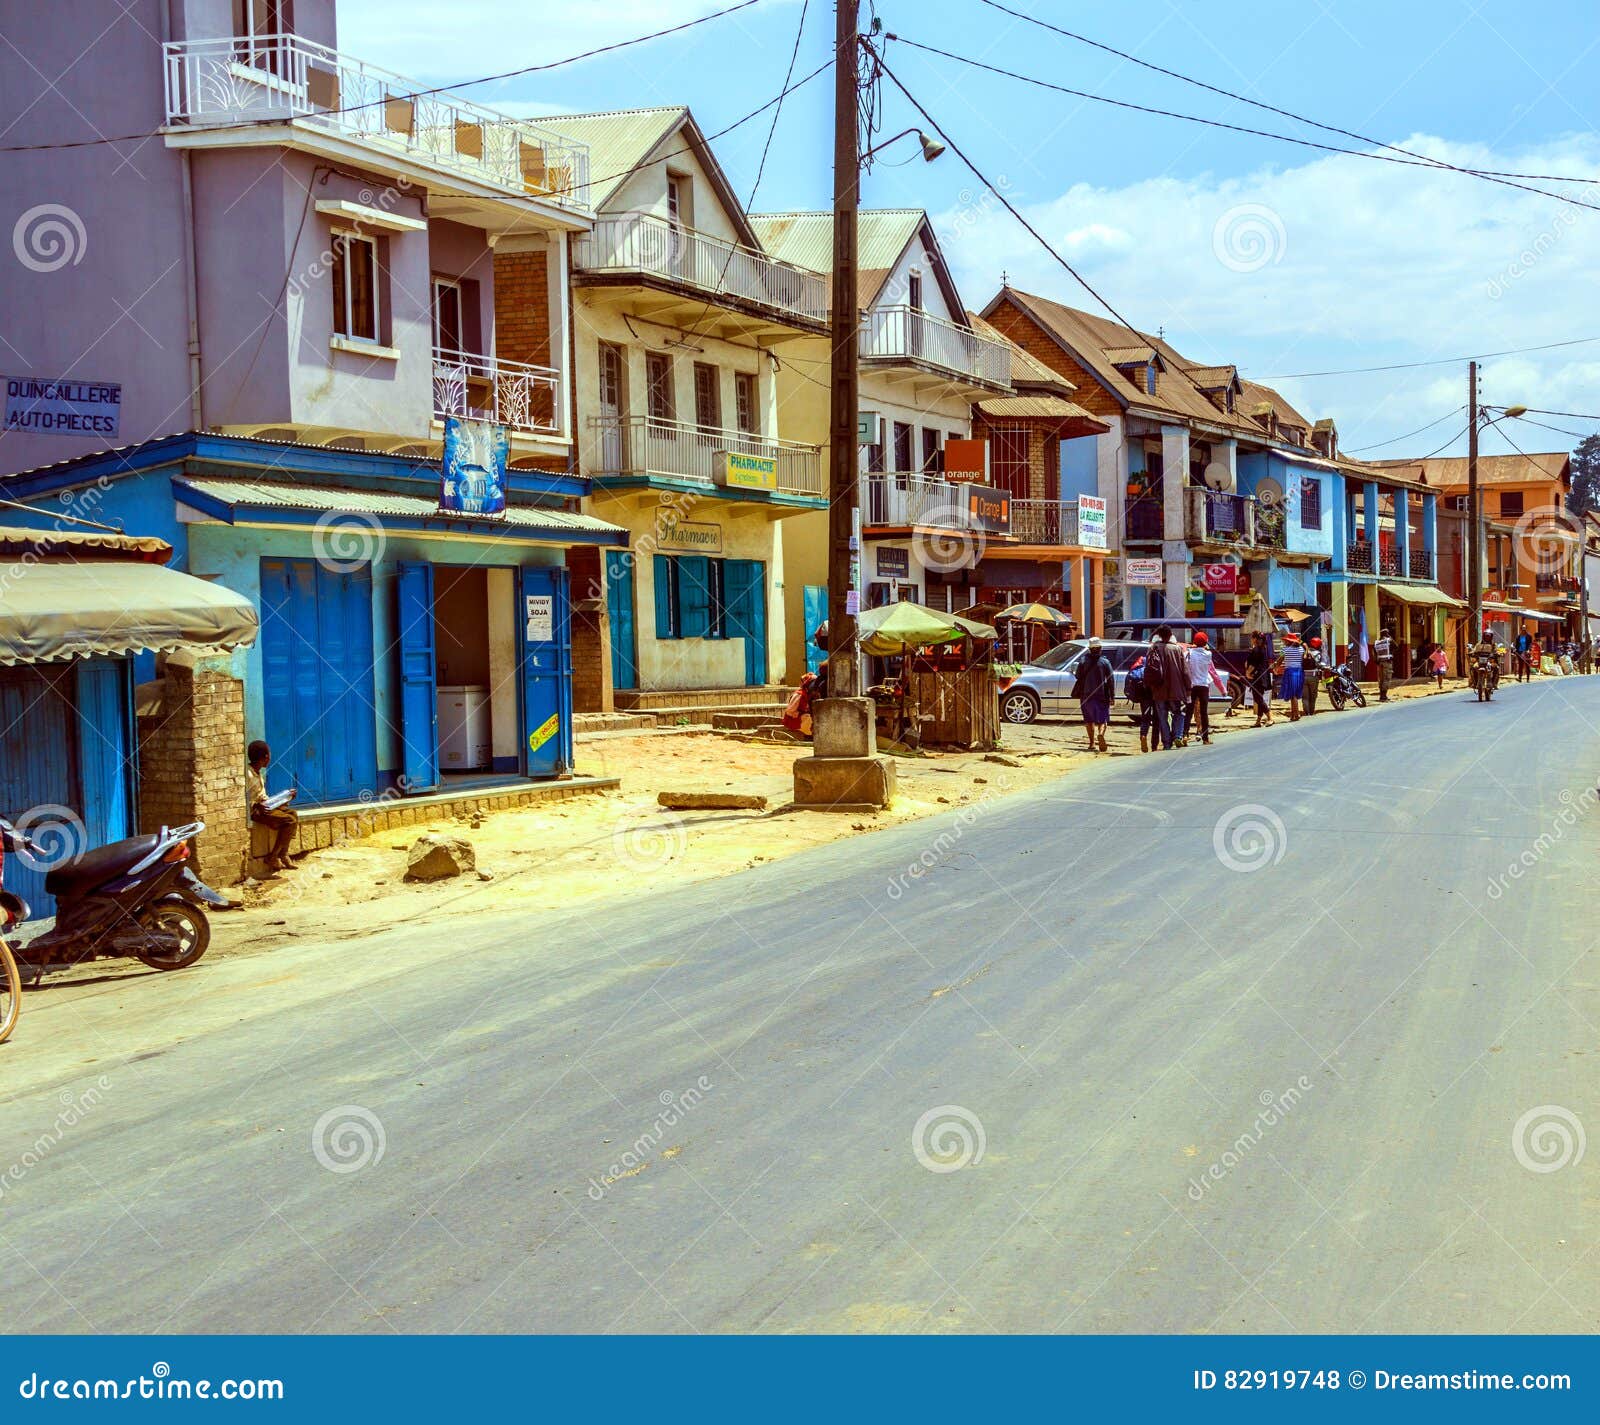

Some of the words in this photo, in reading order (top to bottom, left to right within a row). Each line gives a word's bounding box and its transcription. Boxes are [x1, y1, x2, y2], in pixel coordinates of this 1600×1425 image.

[8, 381, 122, 404] QUINCAILLERIE
[9, 410, 115, 432] AUTO-PIECES
[731, 455, 774, 473] PHARMACIE
[947, 470, 980, 480] orange
[979, 497, 1001, 522] Orange
[660, 512, 718, 545] Pharmacie
